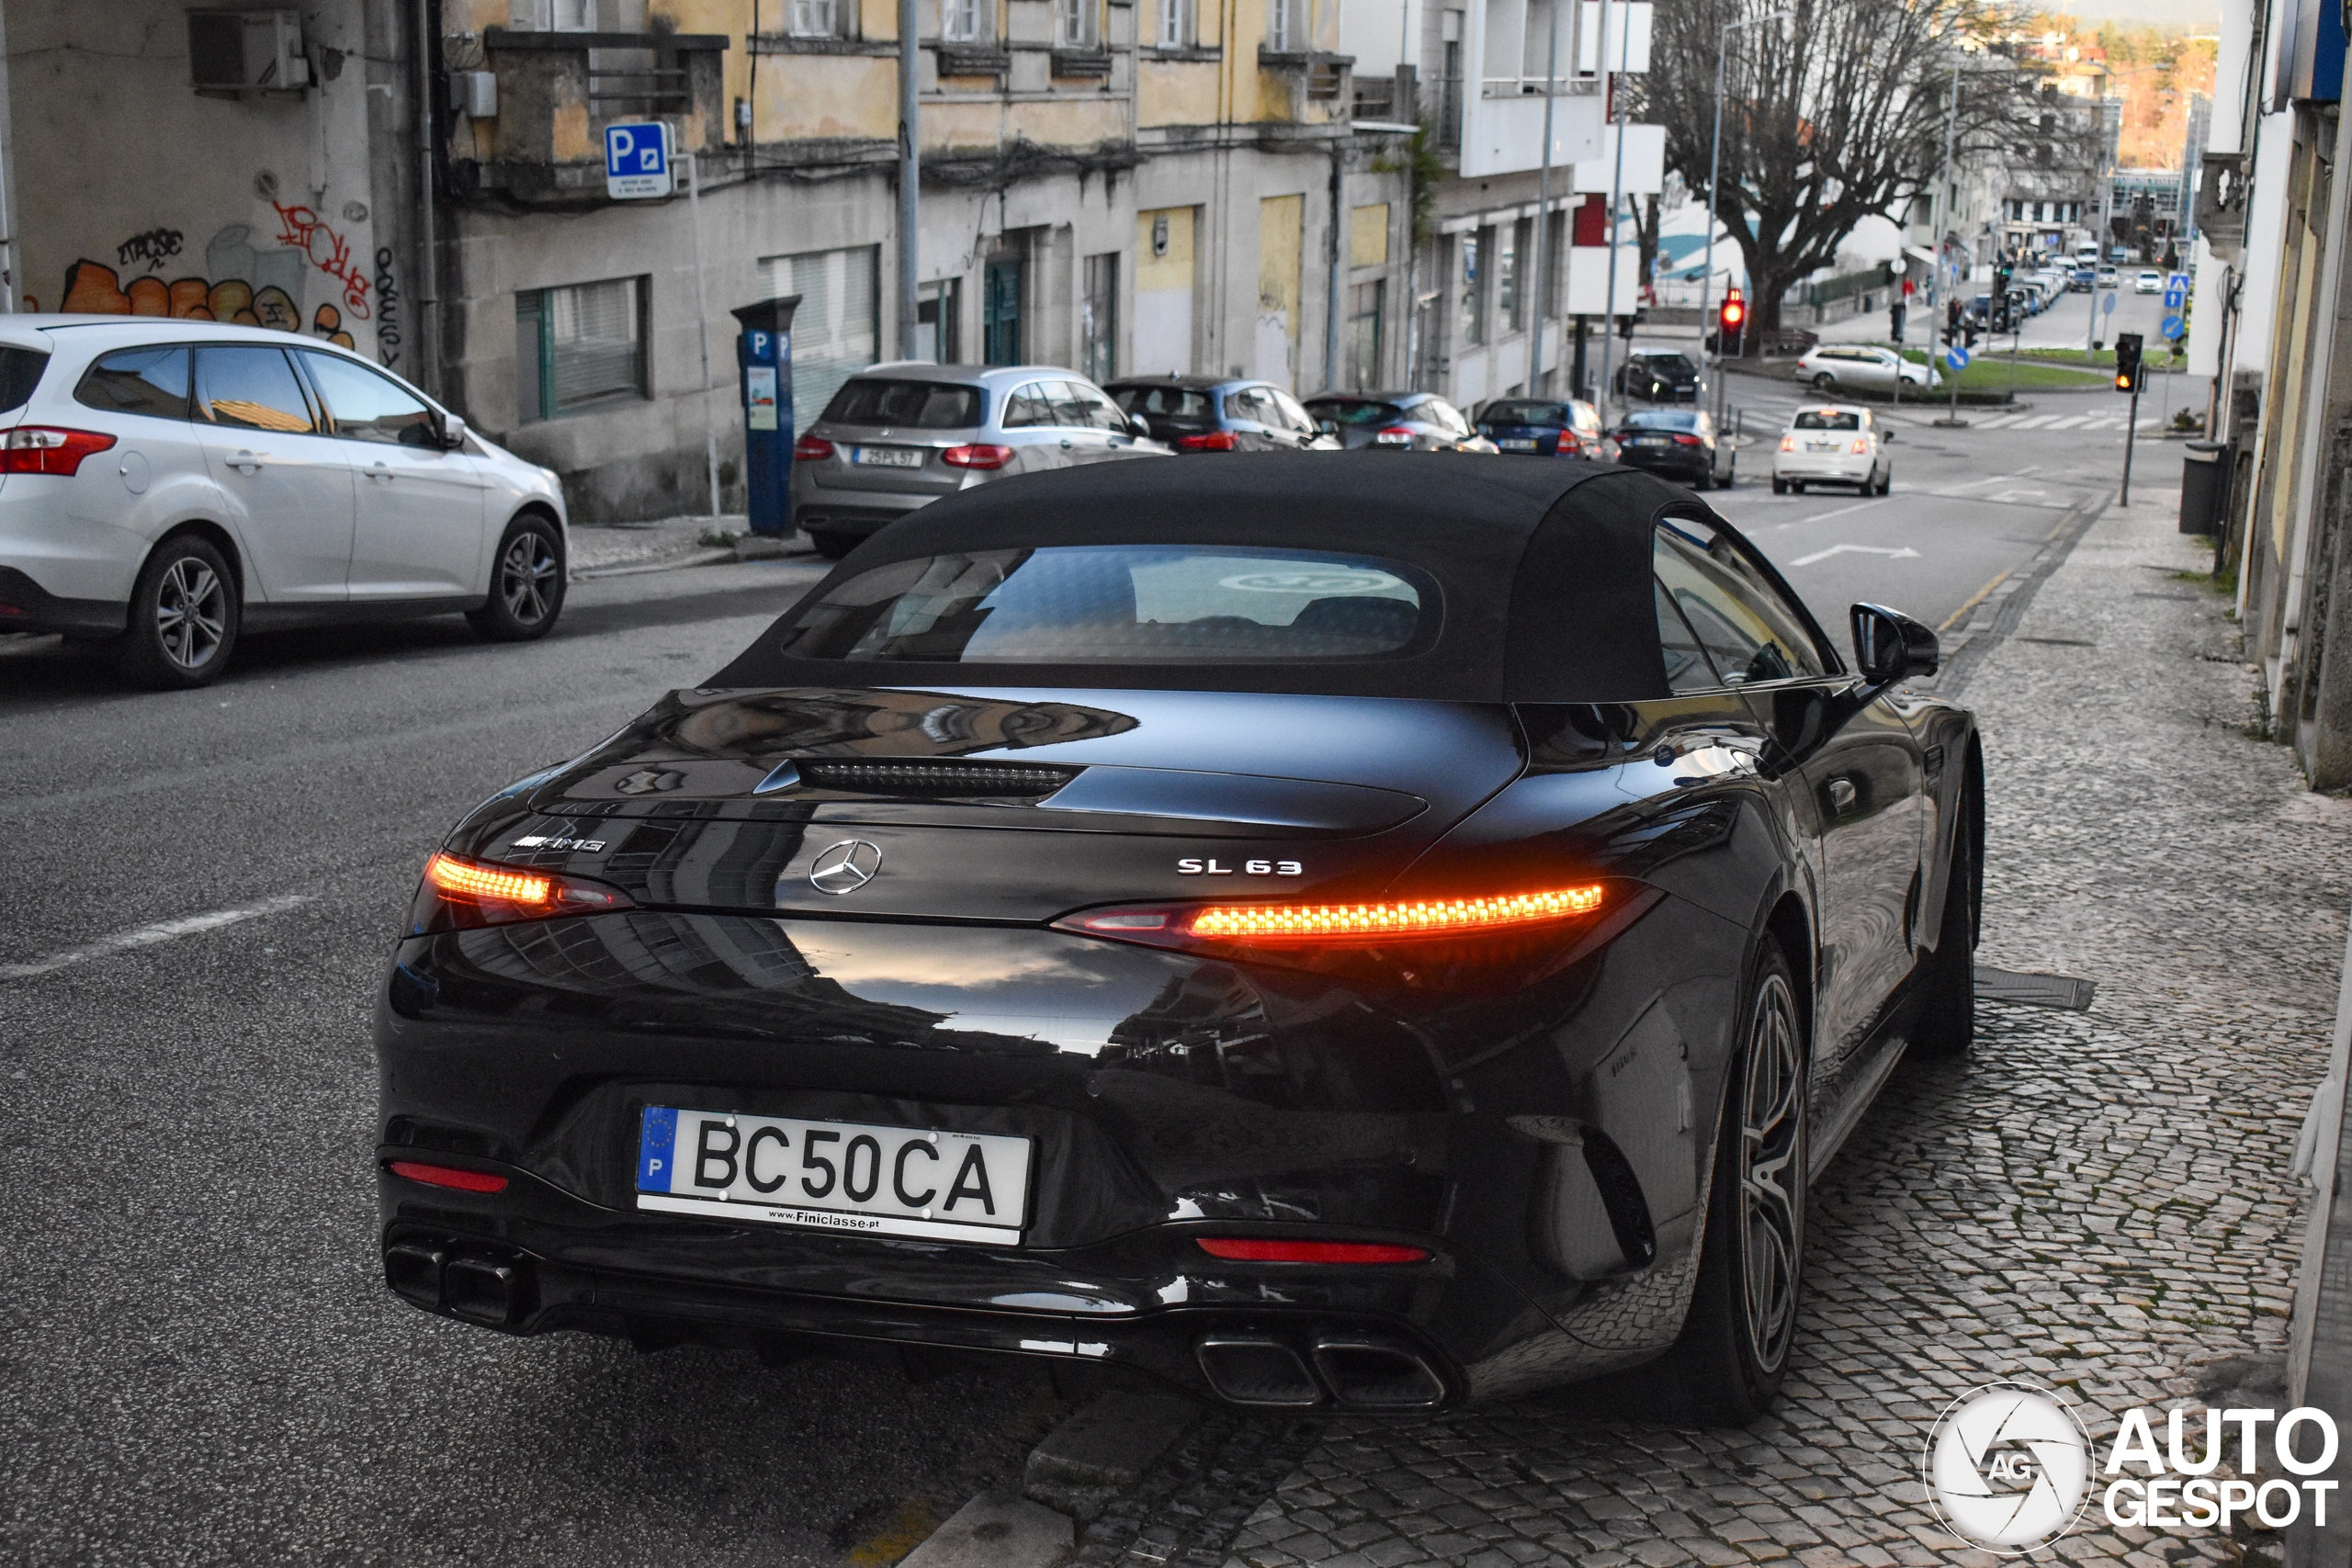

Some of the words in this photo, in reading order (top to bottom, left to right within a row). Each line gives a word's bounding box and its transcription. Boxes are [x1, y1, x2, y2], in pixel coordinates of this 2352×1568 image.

[609, 130, 635, 173] P
[754, 333, 767, 355] P
[779, 334, 789, 358] P
[538, 837, 606, 852] AMG
[1178, 859, 1233, 874] SL
[1245, 860, 1303, 875] 63
[649, 1158, 663, 1177] P
[768, 1211, 879, 1229] www.Finiclasse.pt
